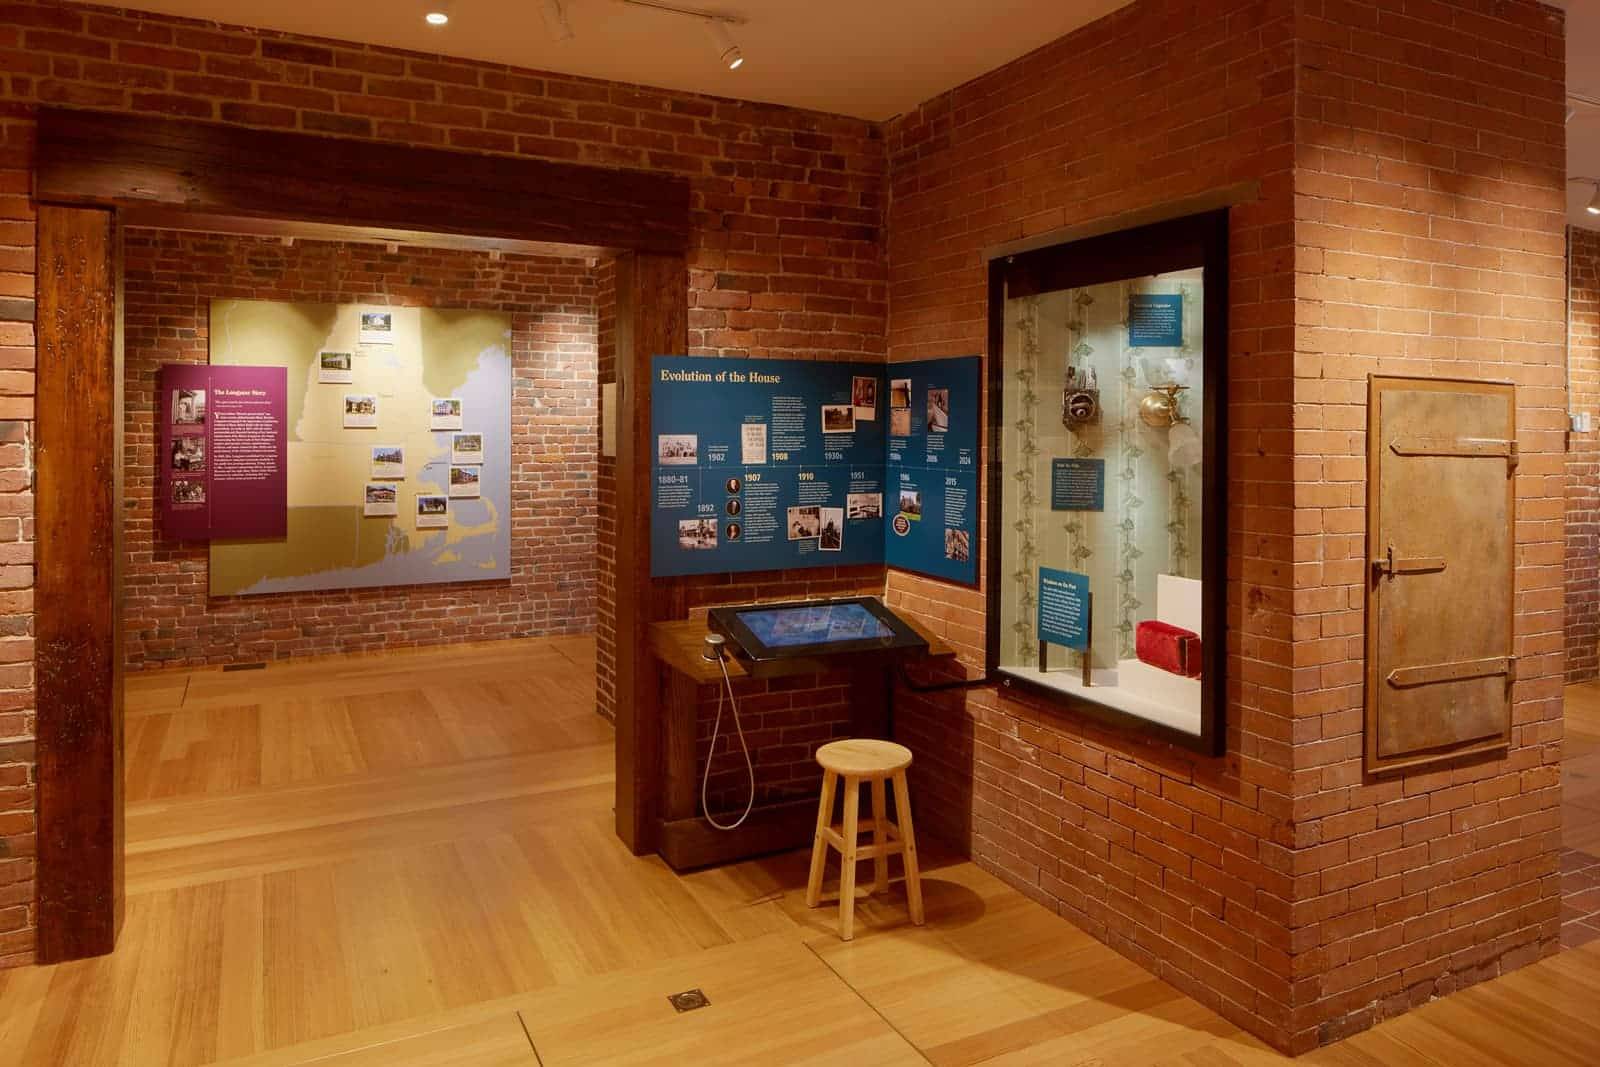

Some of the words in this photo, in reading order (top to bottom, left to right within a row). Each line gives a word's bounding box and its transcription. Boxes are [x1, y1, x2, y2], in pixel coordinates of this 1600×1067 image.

[660, 369, 712, 382] Evolution
[715, 371, 727, 383] of
[729, 371, 746, 383] the
[749, 371, 781, 384] House
[708, 453, 726, 462] 1902
[744, 473, 761, 482] 1907
[697, 503, 715, 513] 1892
